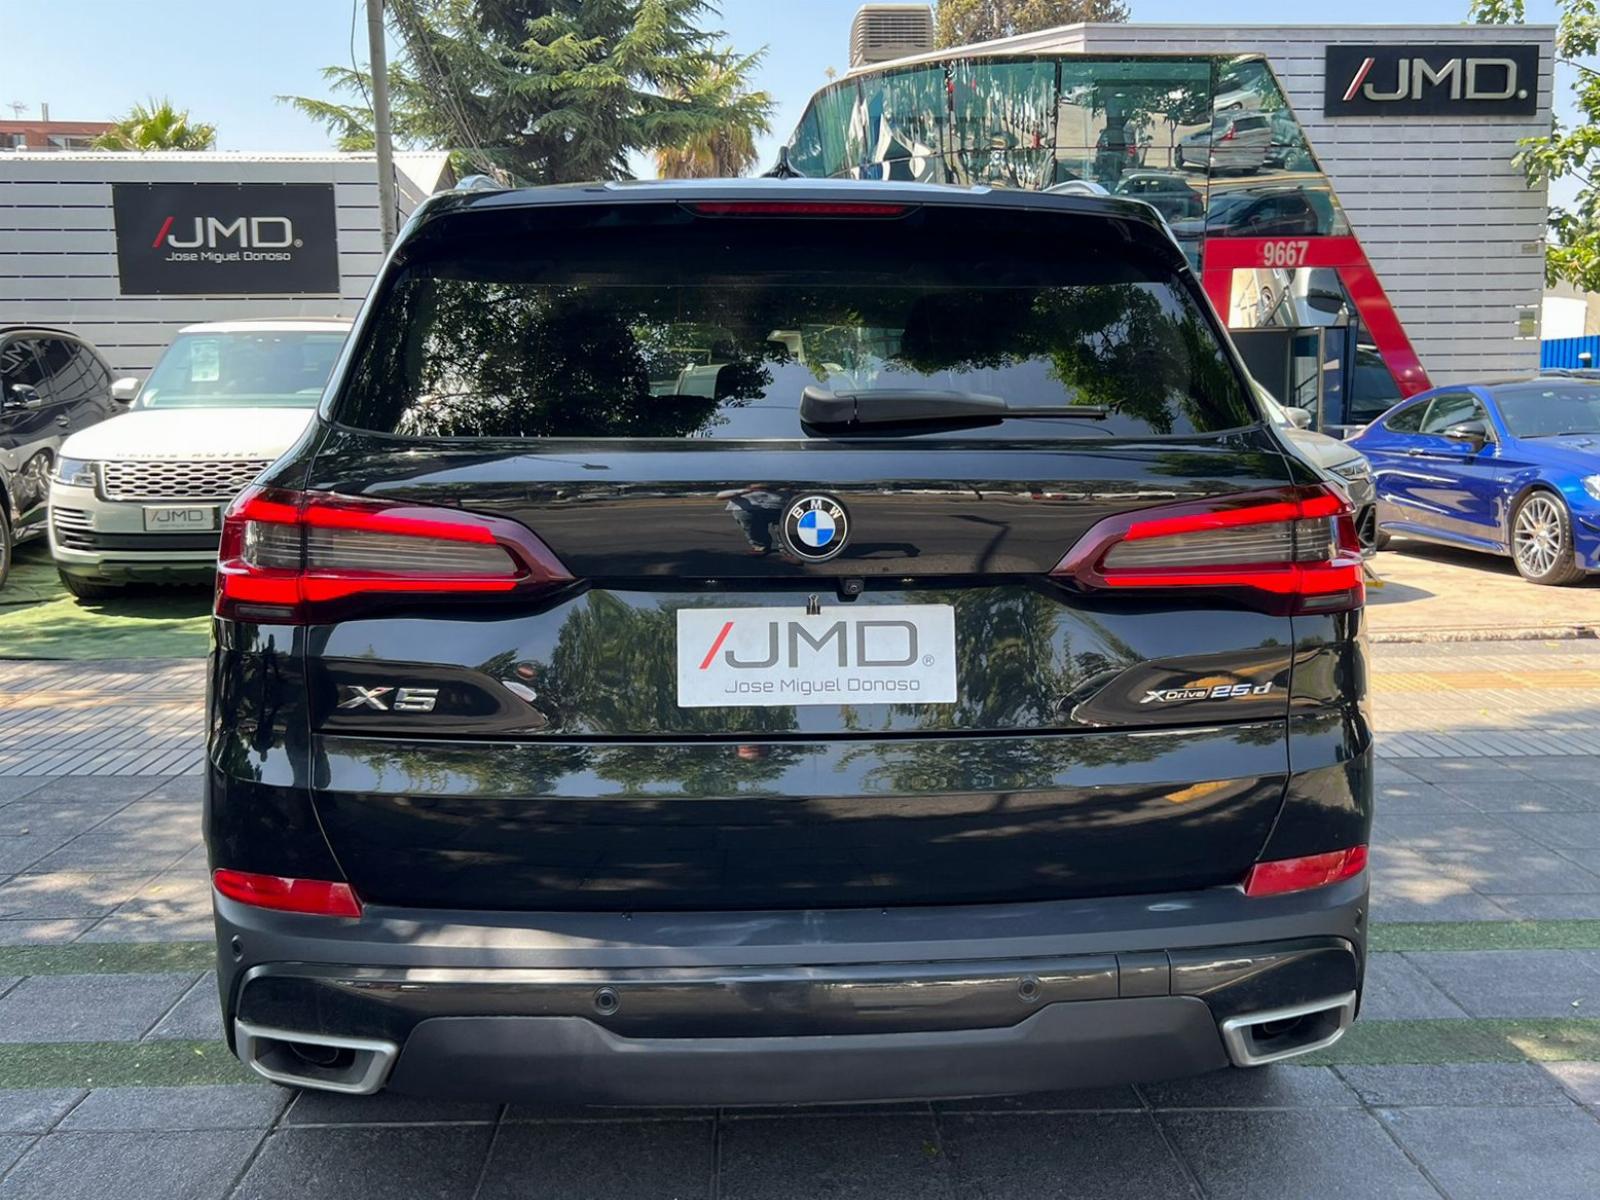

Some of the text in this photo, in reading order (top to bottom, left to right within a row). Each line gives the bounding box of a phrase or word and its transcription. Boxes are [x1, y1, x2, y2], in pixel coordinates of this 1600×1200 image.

[165, 251, 291, 263] Jose Miguel Donoso
[1263, 241, 1309, 267] 9667
[792, 499, 842, 519] BMW
[725, 678, 920, 696] Jose Miguel Donoso
[336, 686, 440, 712] X5
